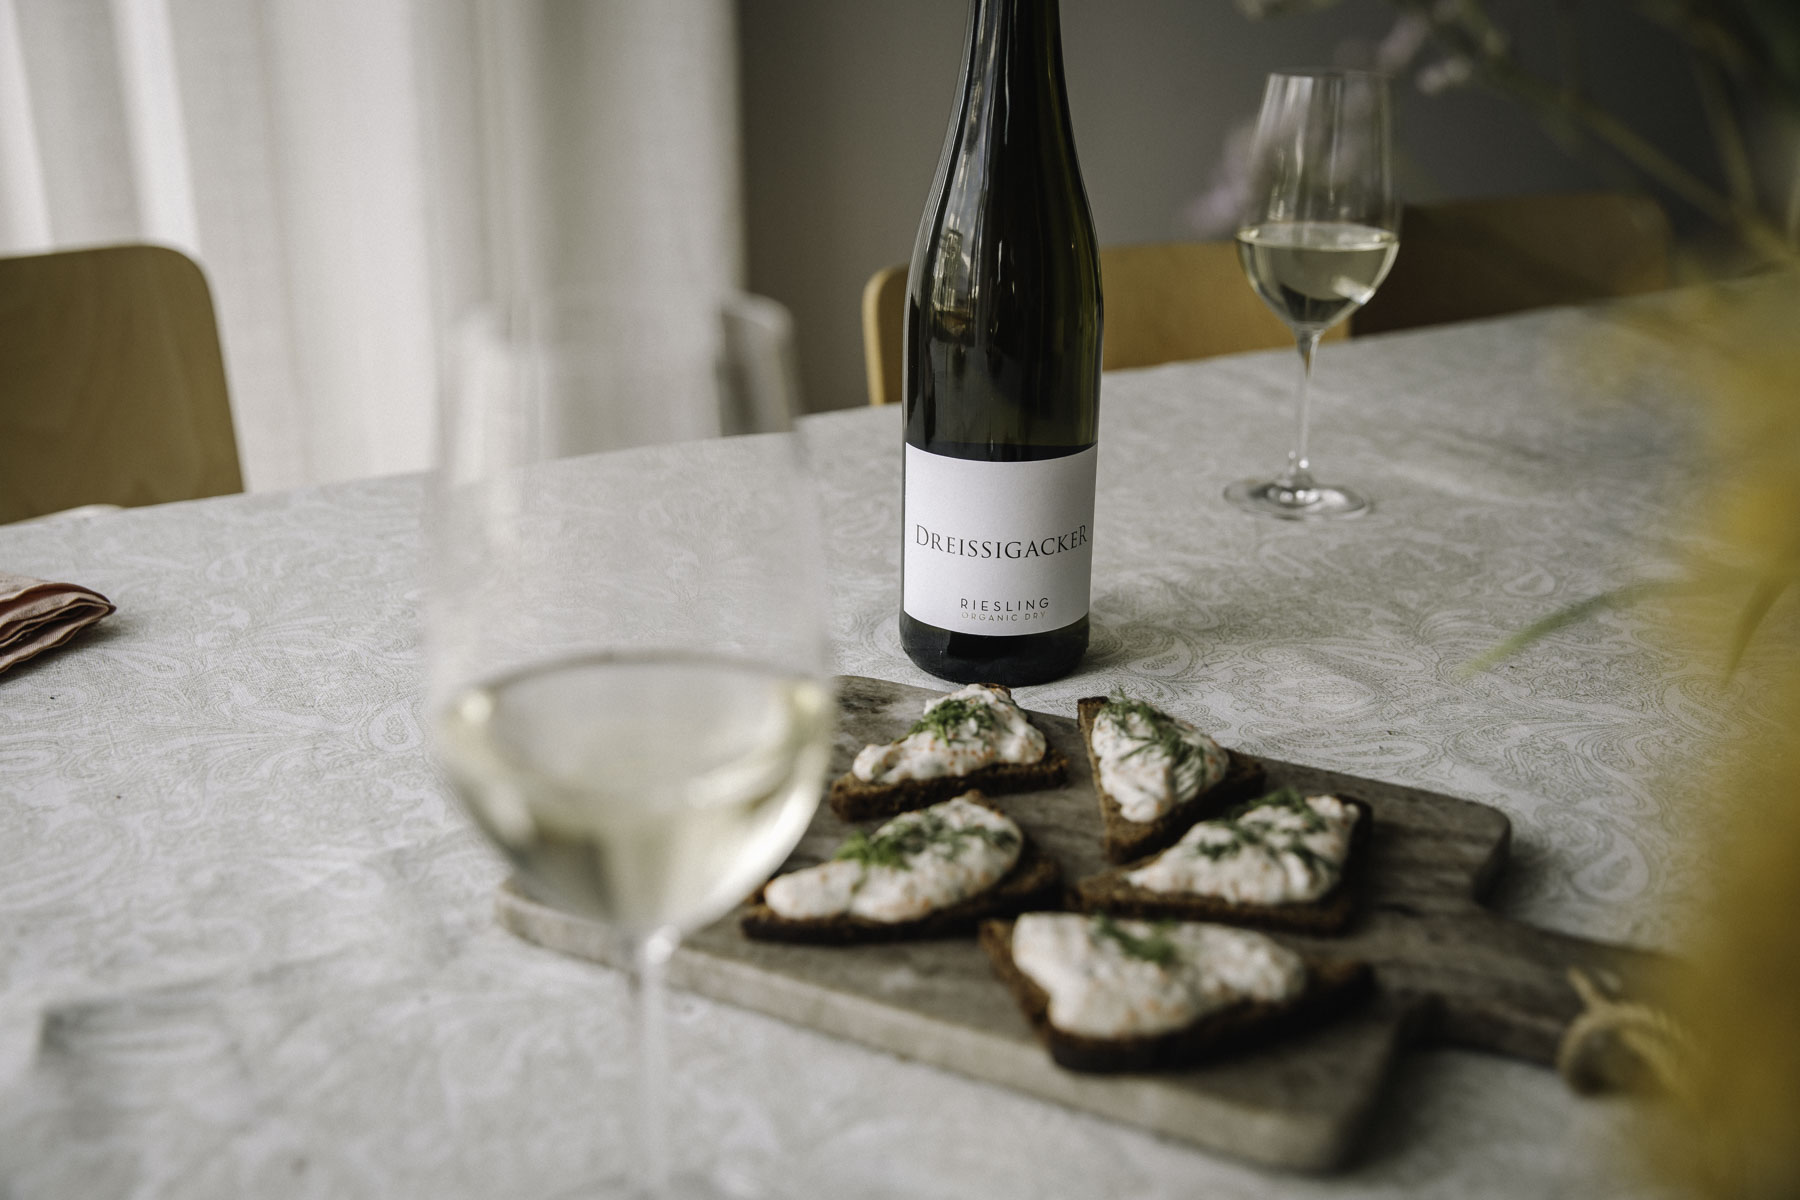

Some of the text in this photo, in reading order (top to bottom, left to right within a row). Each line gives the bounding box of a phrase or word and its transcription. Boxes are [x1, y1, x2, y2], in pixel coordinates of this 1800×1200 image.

[915, 524, 1088, 559] DREISSIGACKER
[960, 597, 1050, 612] RIESLING
[961, 611, 1047, 622] ORGANIC DRY
